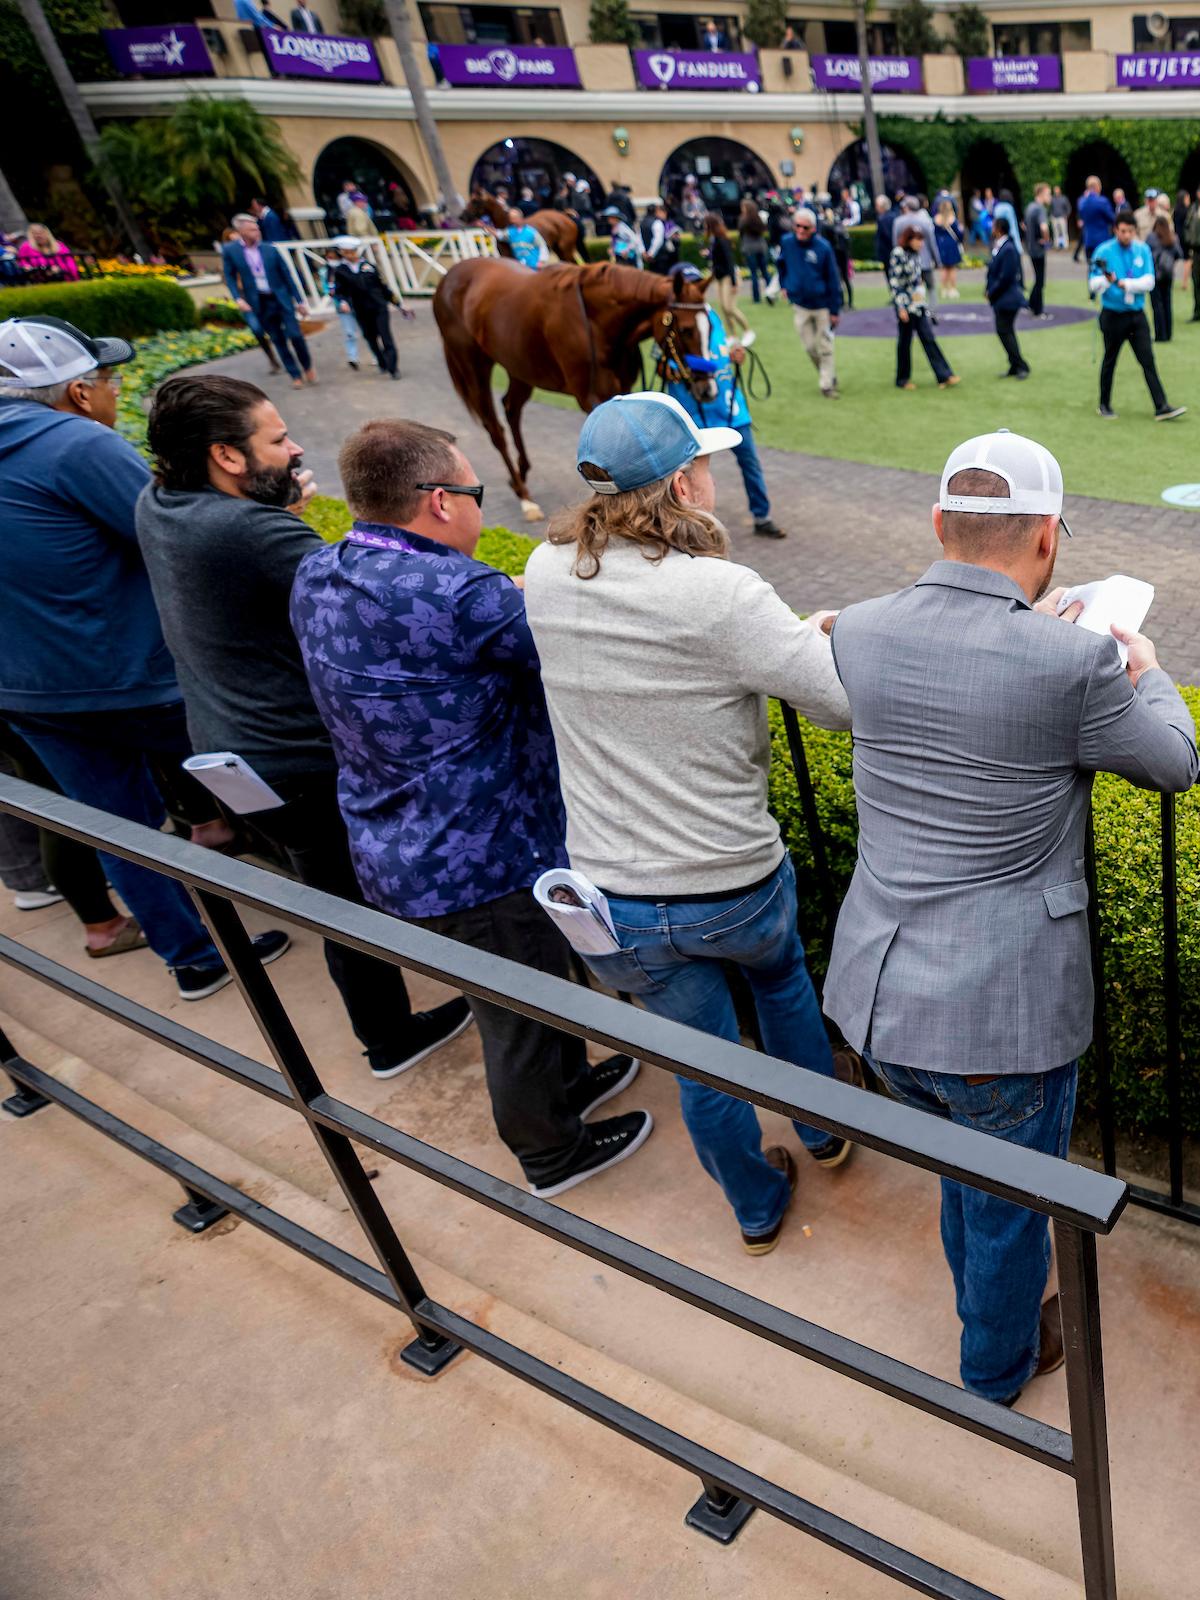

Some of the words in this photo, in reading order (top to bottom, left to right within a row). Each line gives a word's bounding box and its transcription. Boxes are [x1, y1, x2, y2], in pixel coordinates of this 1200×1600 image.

[268, 34, 371, 62] LONGINES
[677, 60, 748, 79] FANDUEL
[824, 58, 910, 78] LONINES
